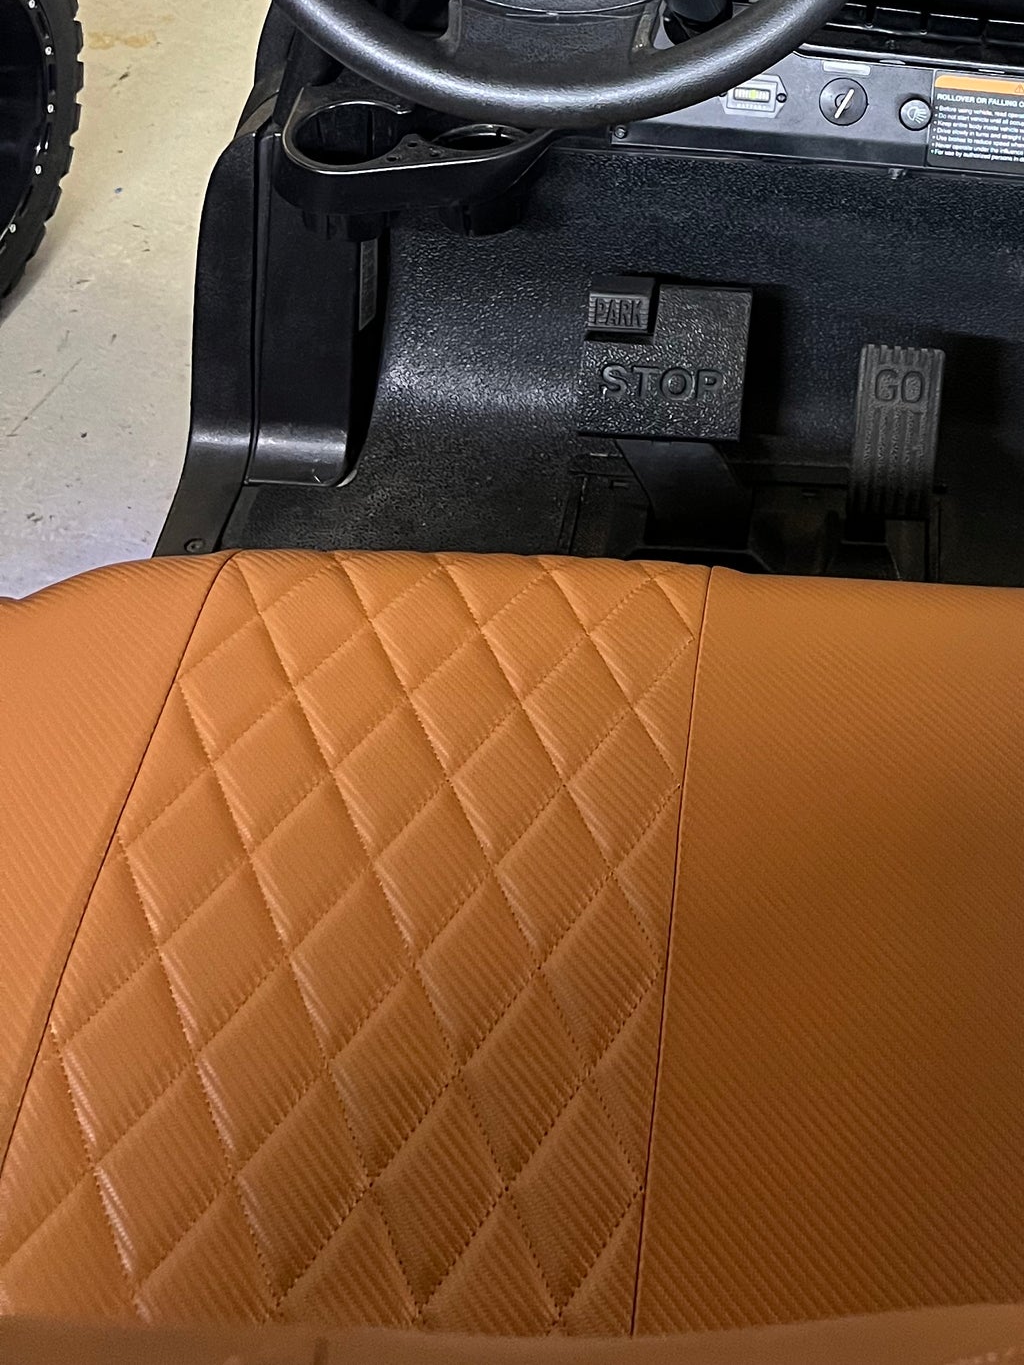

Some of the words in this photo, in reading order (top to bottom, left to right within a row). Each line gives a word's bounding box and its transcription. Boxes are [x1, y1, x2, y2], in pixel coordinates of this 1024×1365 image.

[936, 93, 975, 103] ROLLOVER
[975, 96, 987, 104] OR
[987, 97, 1018, 107] FALLING
[594, 298, 643, 327] PARK
[599, 363, 722, 401] STOP
[874, 367, 925, 403] GO
